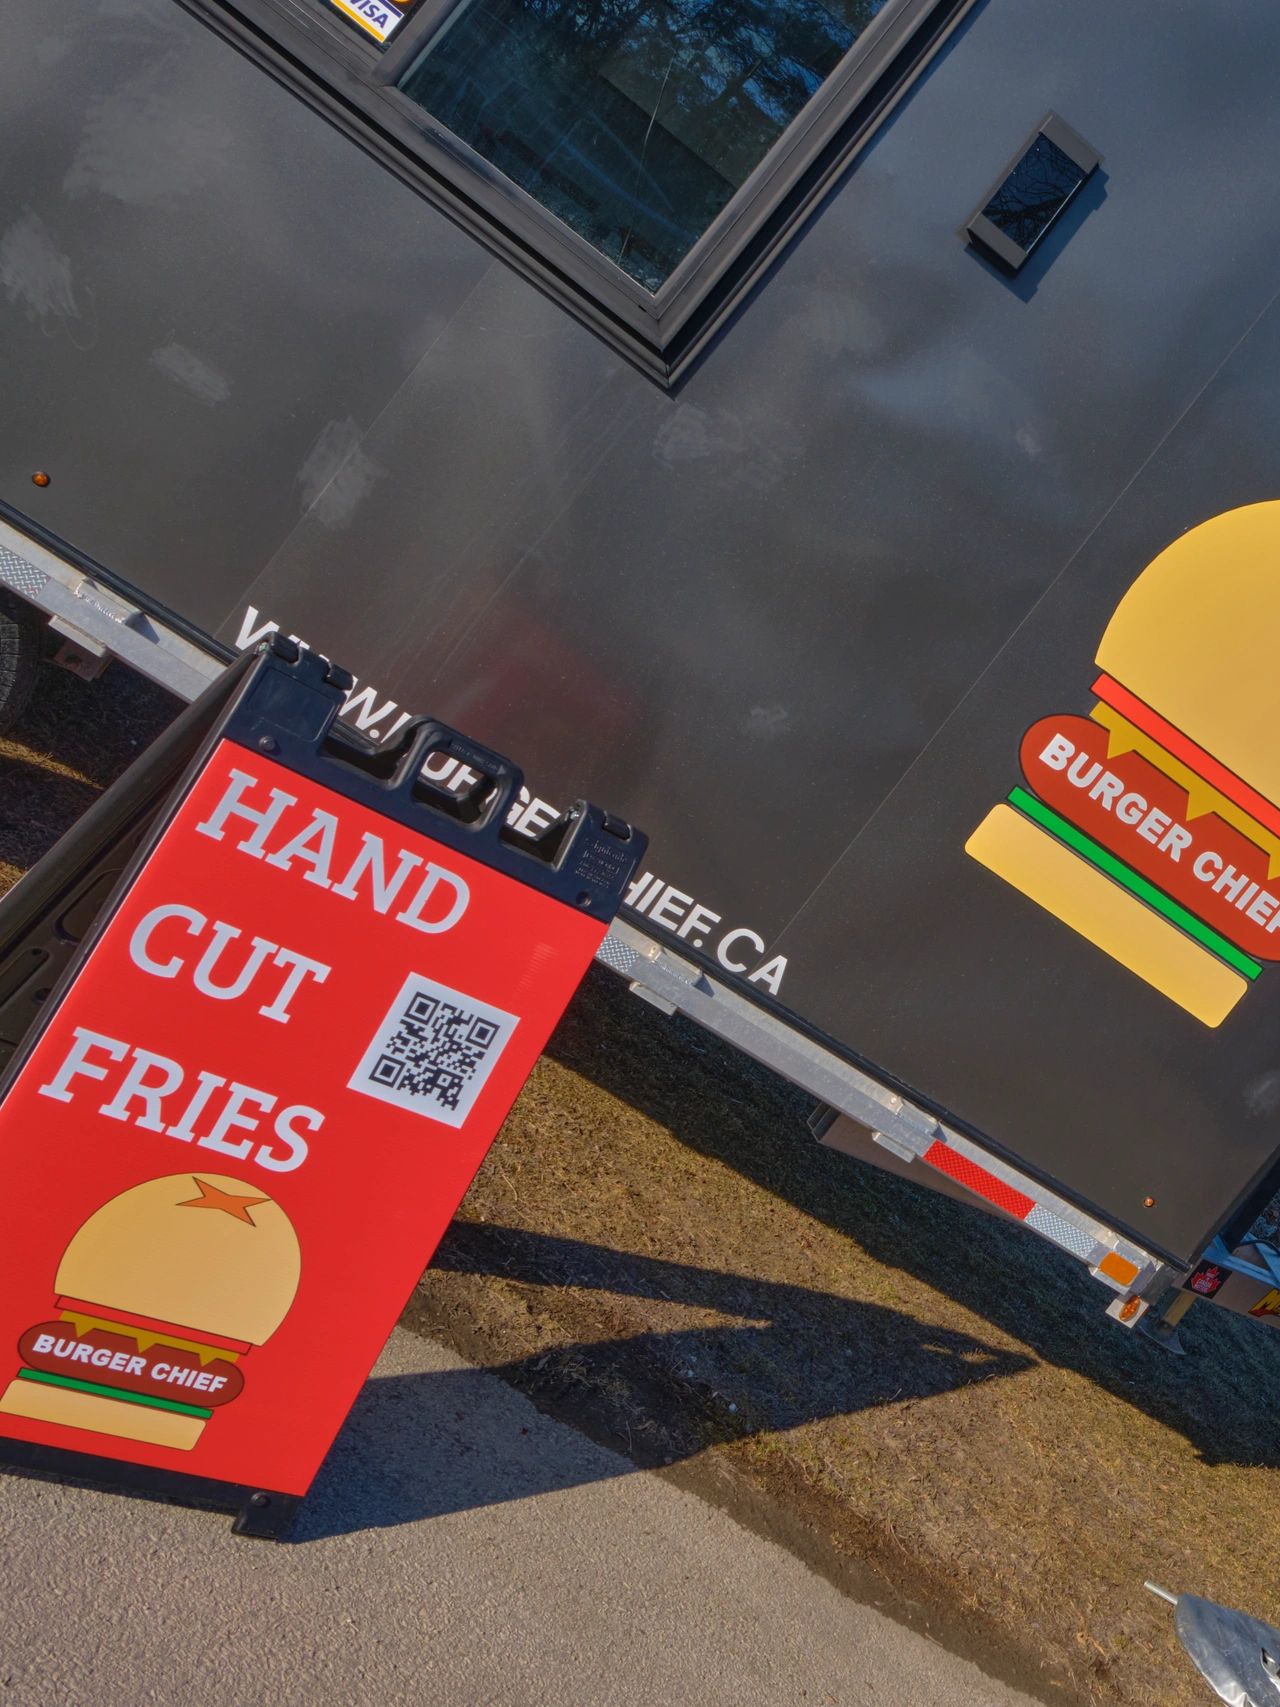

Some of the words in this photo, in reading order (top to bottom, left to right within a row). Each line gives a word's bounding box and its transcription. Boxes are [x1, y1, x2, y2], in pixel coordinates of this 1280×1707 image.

[195, 768, 470, 935] HAND
[1038, 733, 1193, 862] BURGER
[128, 903, 330, 1025] CUT
[38, 1027, 326, 1173] FRIES
[32, 1334, 147, 1376] BURGER
[151, 1362, 229, 1393] CHIEF
